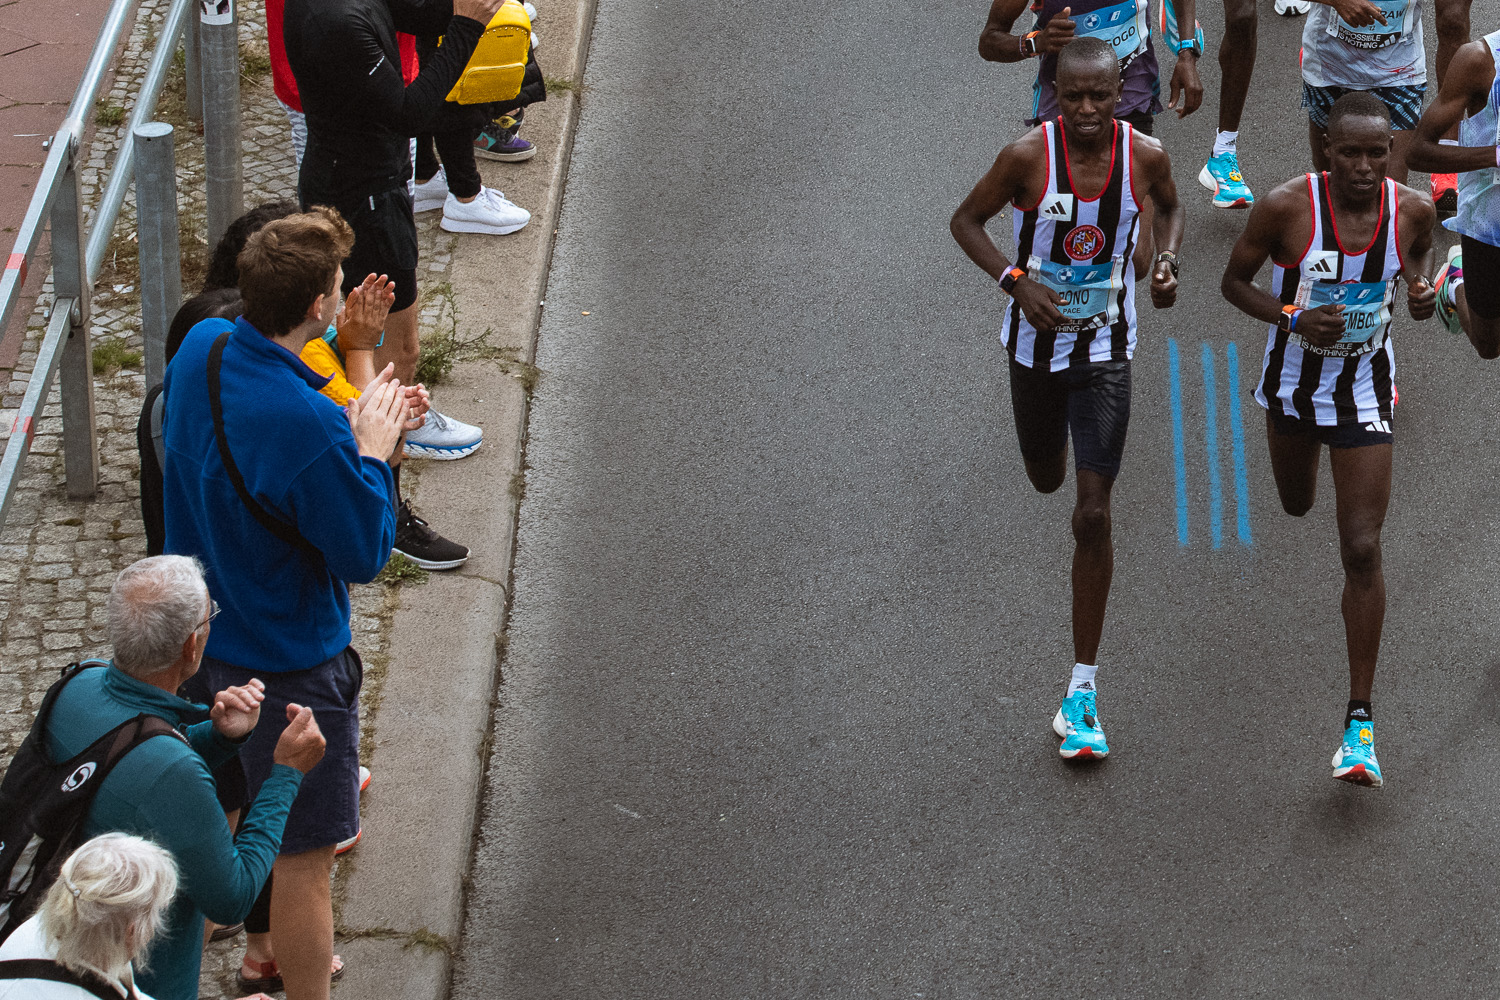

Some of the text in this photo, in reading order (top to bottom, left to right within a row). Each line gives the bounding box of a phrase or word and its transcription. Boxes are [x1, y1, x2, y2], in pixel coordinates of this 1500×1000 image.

[1340, 27, 1382, 42] IMPOSSIBLE
[1345, 37, 1378, 49] NOTHING
[1301, 341, 1309, 349] IS
[1309, 345, 1349, 357] NOTHING
